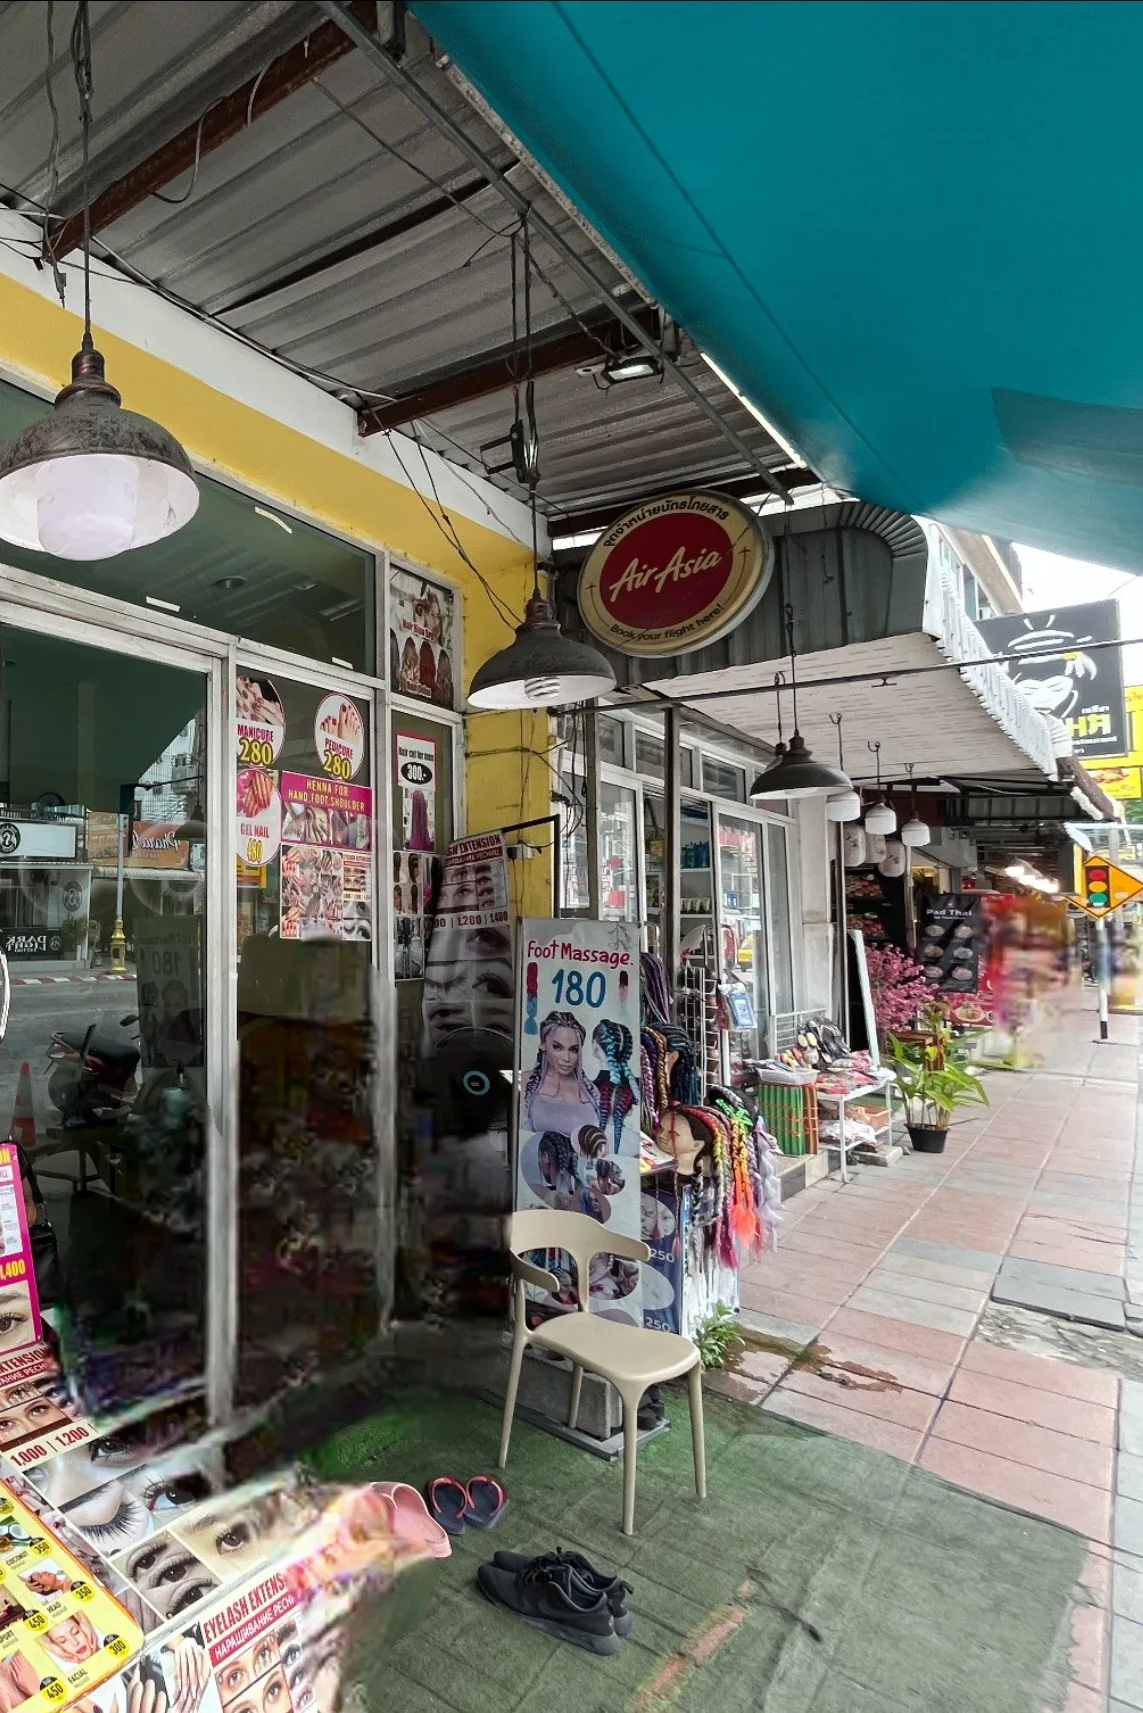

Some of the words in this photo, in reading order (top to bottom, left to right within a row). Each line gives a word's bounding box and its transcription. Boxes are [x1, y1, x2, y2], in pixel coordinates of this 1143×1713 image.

[610, 623, 635, 639] Book
[634, 629, 661, 641] your
[664, 623, 695, 638] flight
[696, 603, 725, 627] here!
[237, 724, 274, 743] MANICURE
[239, 737, 274, 766] 280
[324, 738, 353, 759] PEDICURE
[323, 750, 352, 780] 280
[335, 783, 349, 798] FOR
[240, 823, 253, 837] GEL
[253, 825, 269, 840] NAIL
[457, 915, 482, 927] 1,200
[527, 940, 559, 961] Foot
[551, 968, 606, 1008] 180
[645, 1315, 671, 1333] 250
[25, 1361, 48, 1378] РЕСН
[10, 1443, 48, 1467] 1,000
[34, 1542, 51, 1556] 350
[75, 1585, 92, 1599] 350
[203, 1597, 249, 1644] EYELASH
[248, 1571, 289, 1612] EXTENS
[28, 1614, 45, 1629] 450
[214, 1614, 274, 1660] НАРАЩИВАНИЕ
[111, 1641, 126, 1656] 300
[67, 1668, 89, 1685] FACIAL
[46, 1683, 64, 1699] 450
